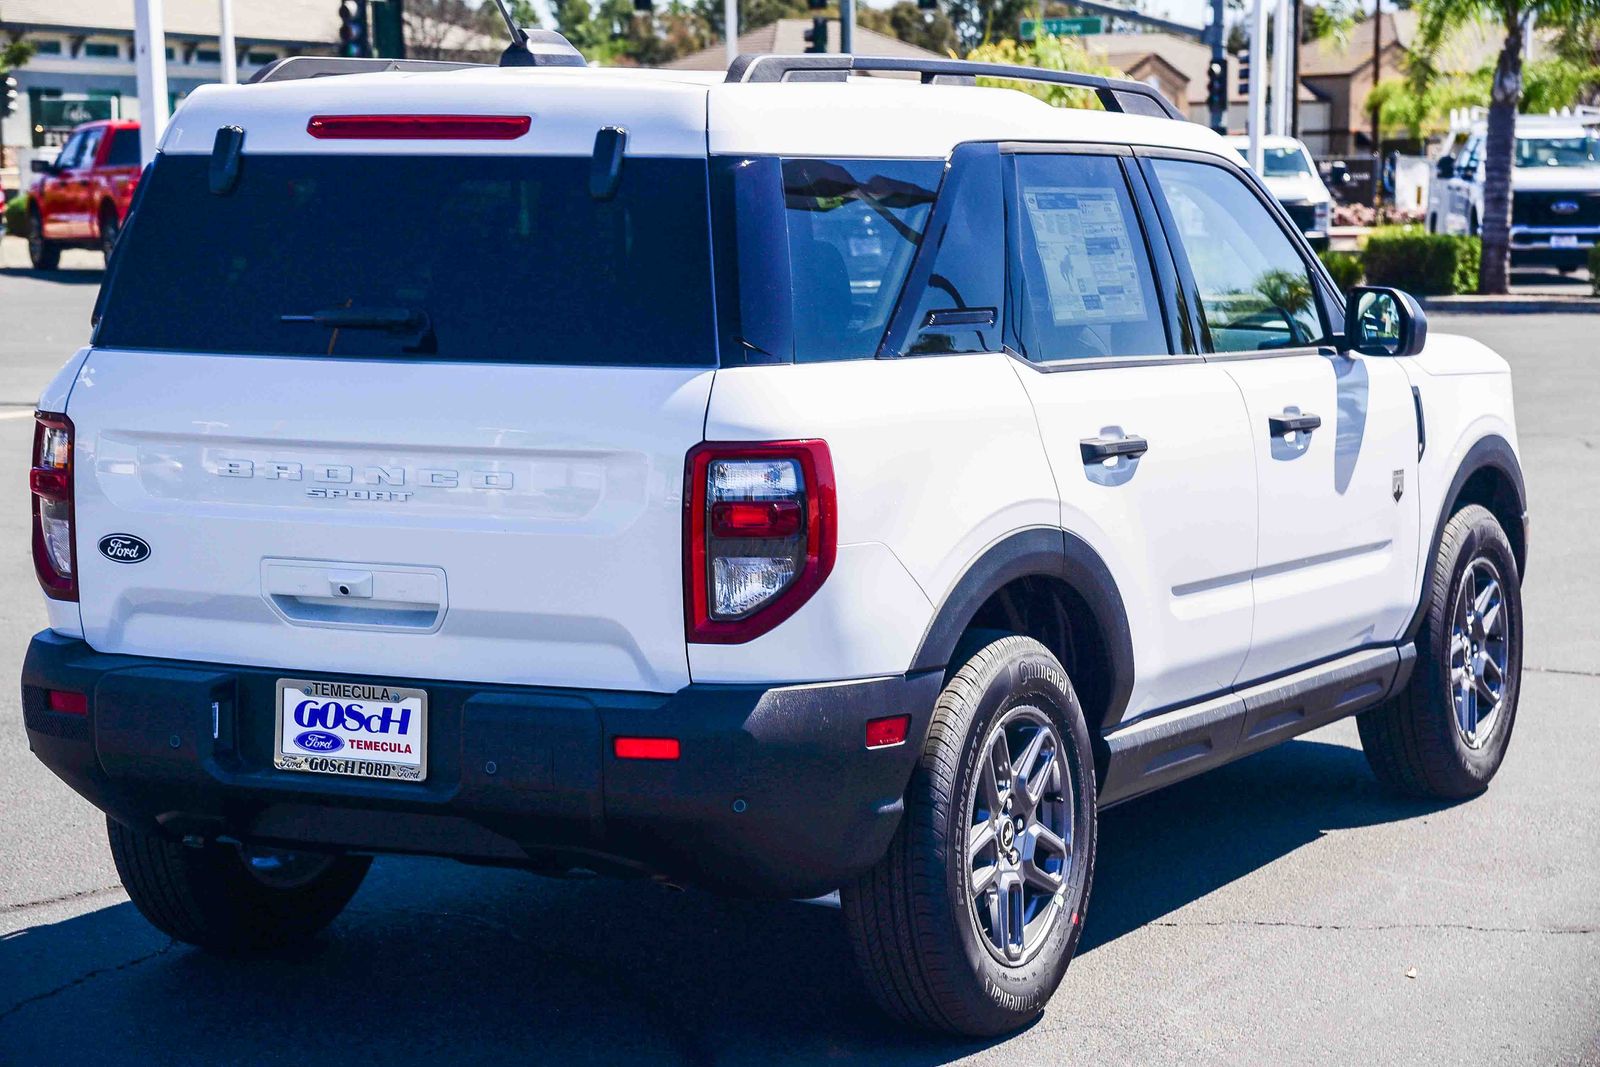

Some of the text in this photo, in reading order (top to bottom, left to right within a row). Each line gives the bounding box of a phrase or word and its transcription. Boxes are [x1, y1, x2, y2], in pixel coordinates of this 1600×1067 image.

[217, 458, 515, 490] BRONCO
[306, 487, 414, 502] SPORT
[107, 538, 139, 558] Ford
[312, 682, 390, 701] TEMECULA
[305, 734, 333, 750] Ford
[349, 739, 412, 754] TEMECULA
[280, 756, 303, 769] Ford
[358, 761, 391, 777] FORD
[397, 766, 421, 780] Ford
